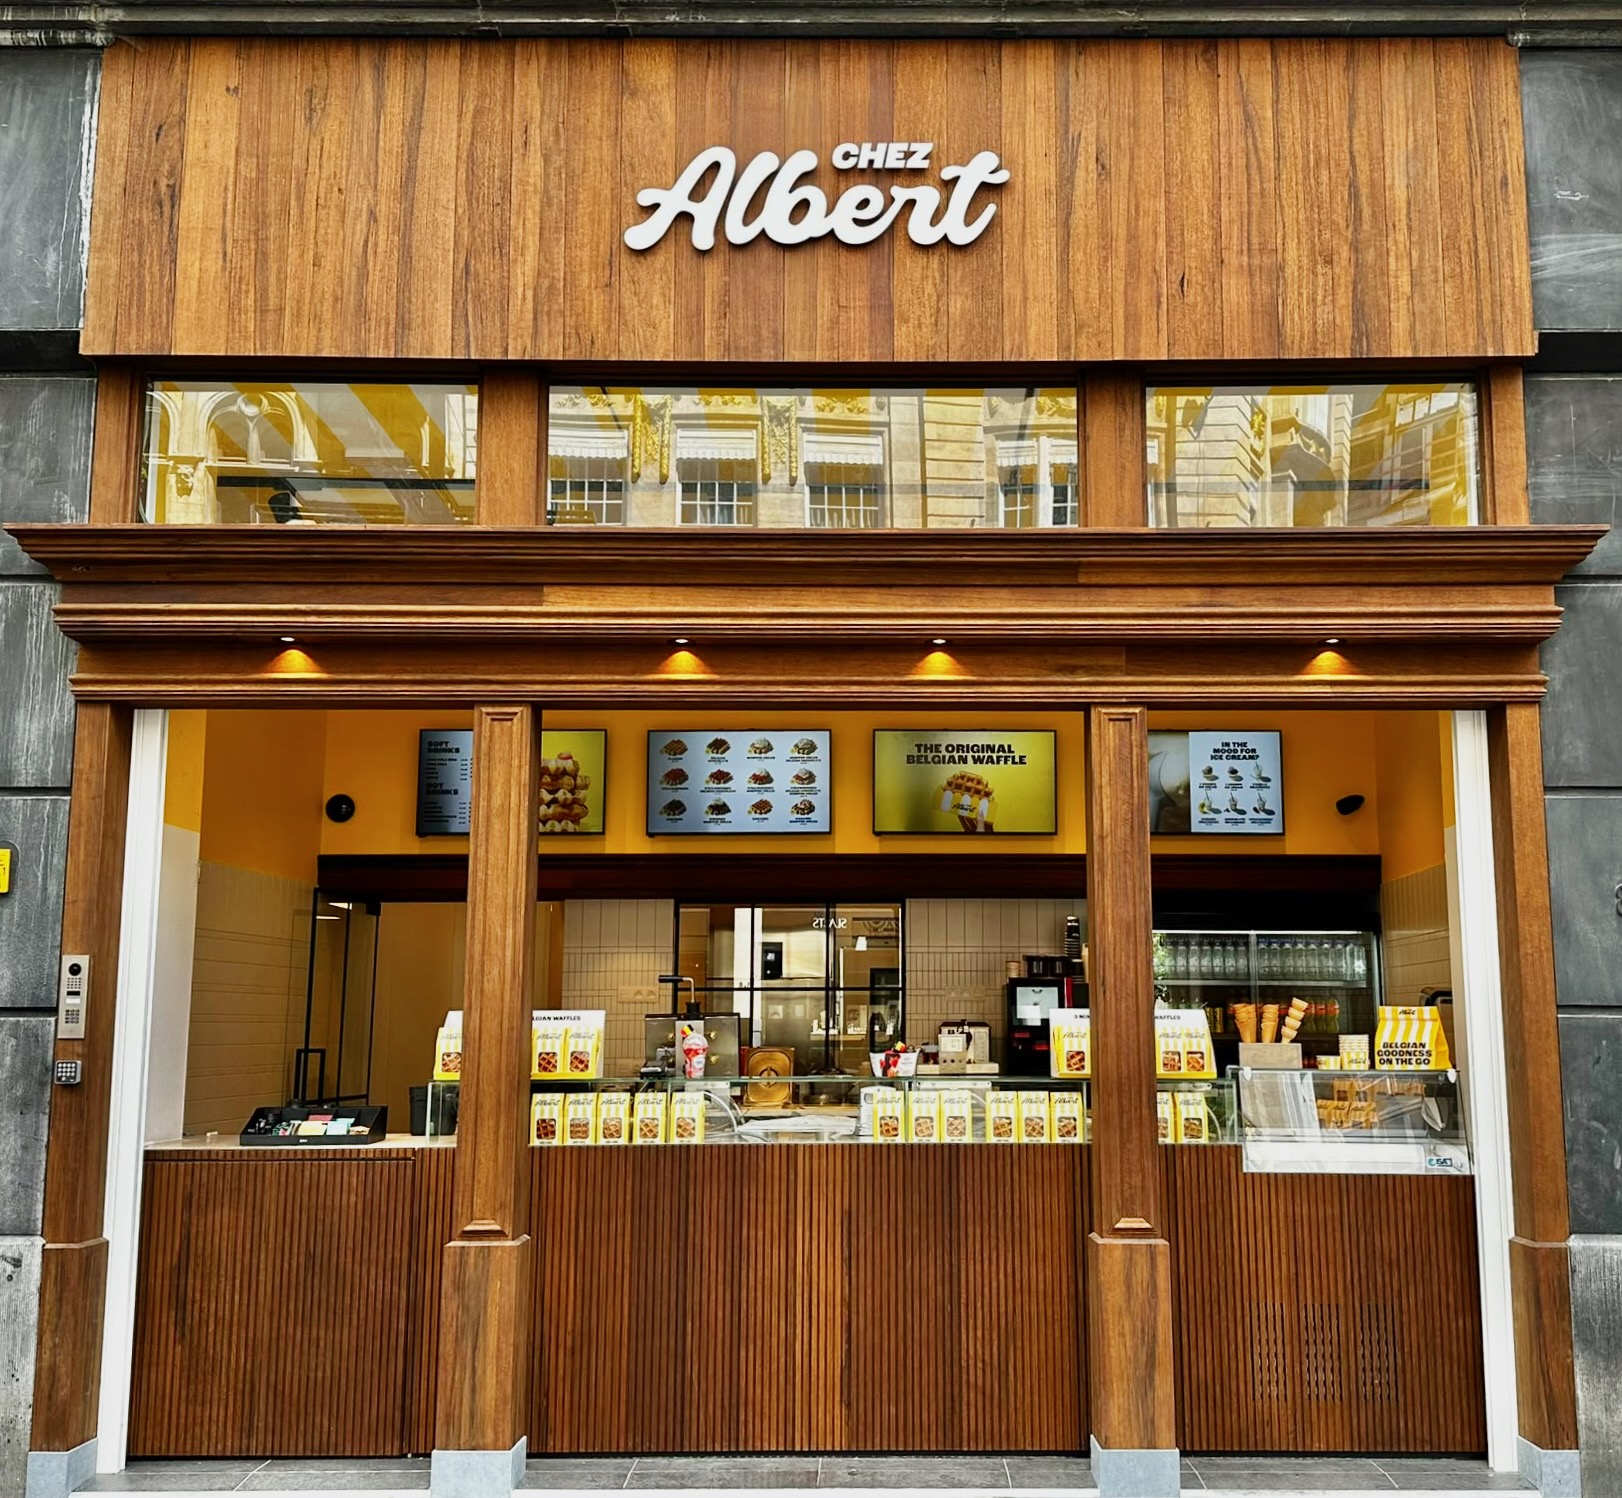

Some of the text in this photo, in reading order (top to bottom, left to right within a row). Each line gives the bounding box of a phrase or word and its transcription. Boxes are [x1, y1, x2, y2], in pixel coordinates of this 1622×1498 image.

[831, 142, 934, 169] CHEZ
[623, 146, 1011, 250] Albert
[915, 744, 1015, 754] THE ORIGINAL
[906, 755, 1027, 765] BELGIAN WAFFLE
